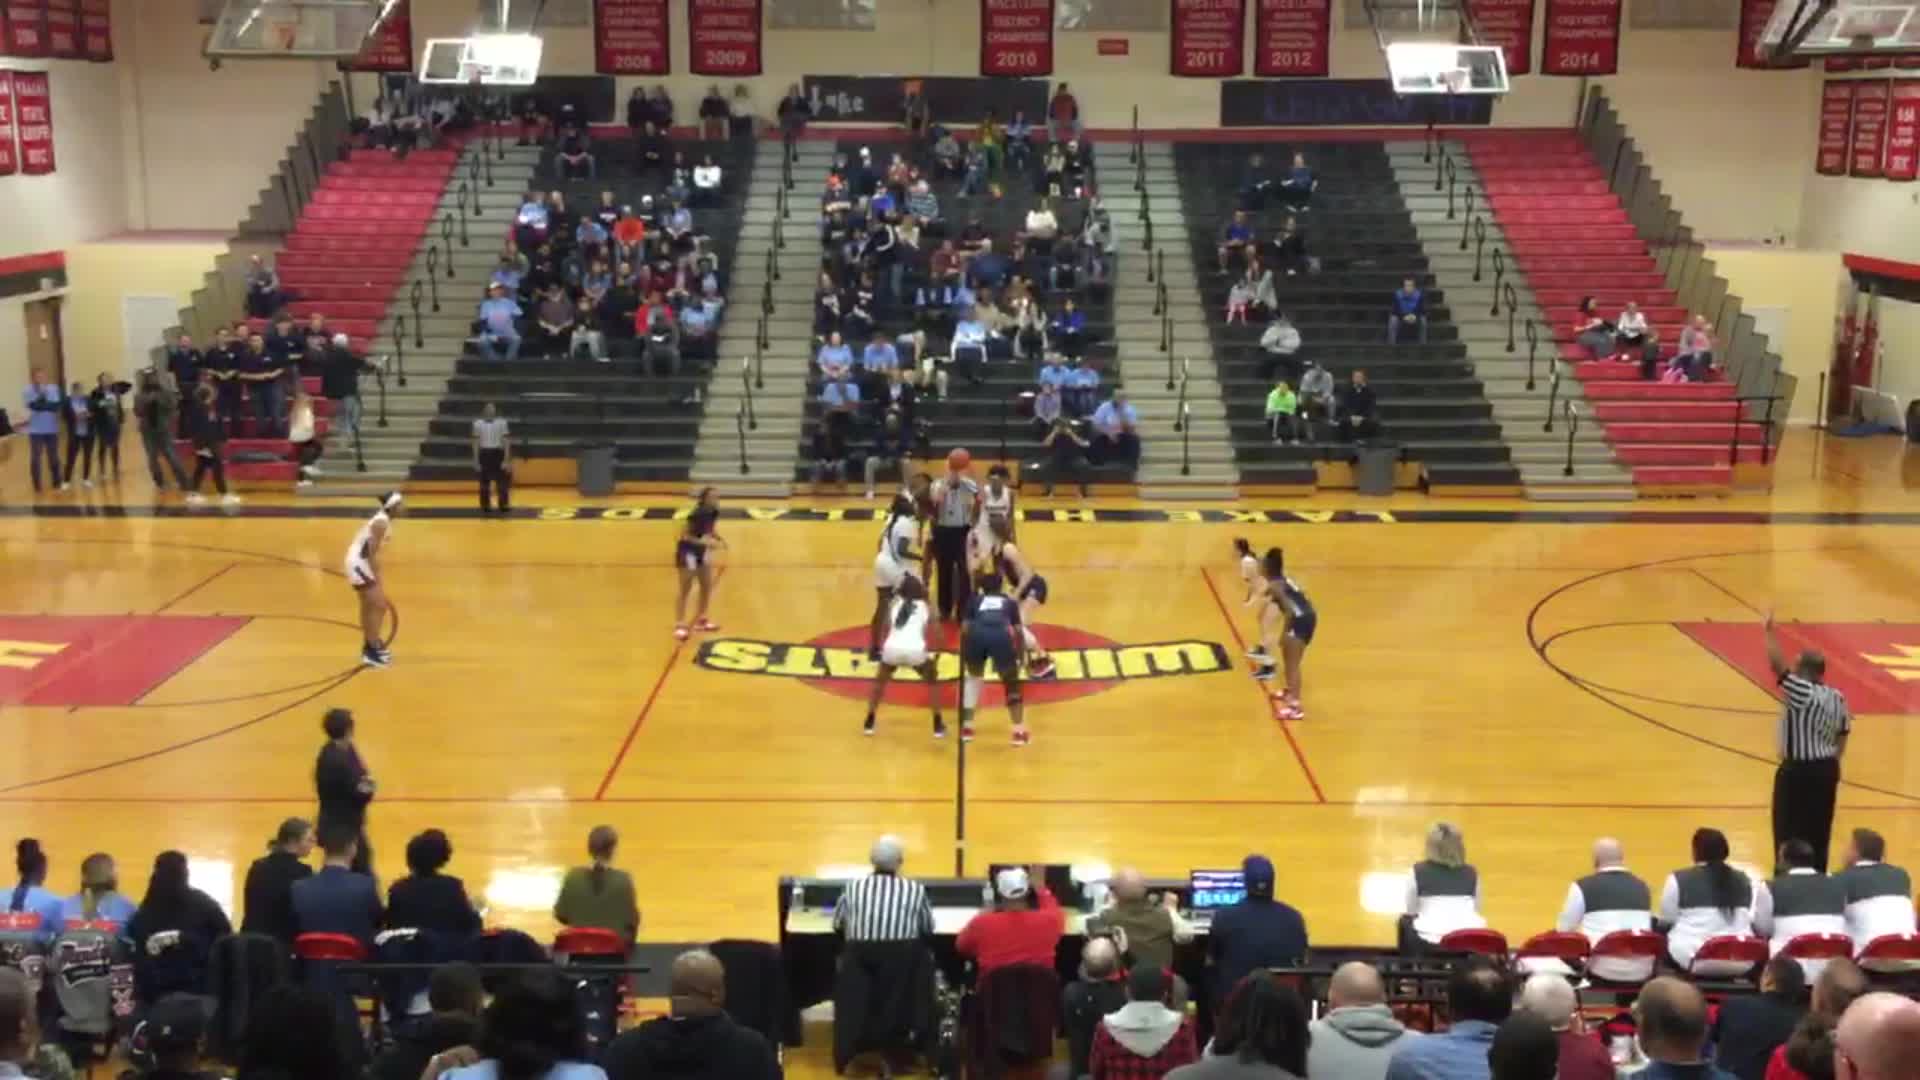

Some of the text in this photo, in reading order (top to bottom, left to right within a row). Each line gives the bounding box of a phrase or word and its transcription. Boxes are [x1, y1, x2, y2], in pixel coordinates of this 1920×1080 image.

[614, 55, 652, 69] 2008
[705, 50, 748, 66] 2009
[996, 52, 1038, 67] 2010
[1185, 52, 1226, 67] 2011
[1271, 52, 1312, 67] 2012
[1559, 52, 1600, 67] 2014
[1166, 509, 1397, 523] LAKE
